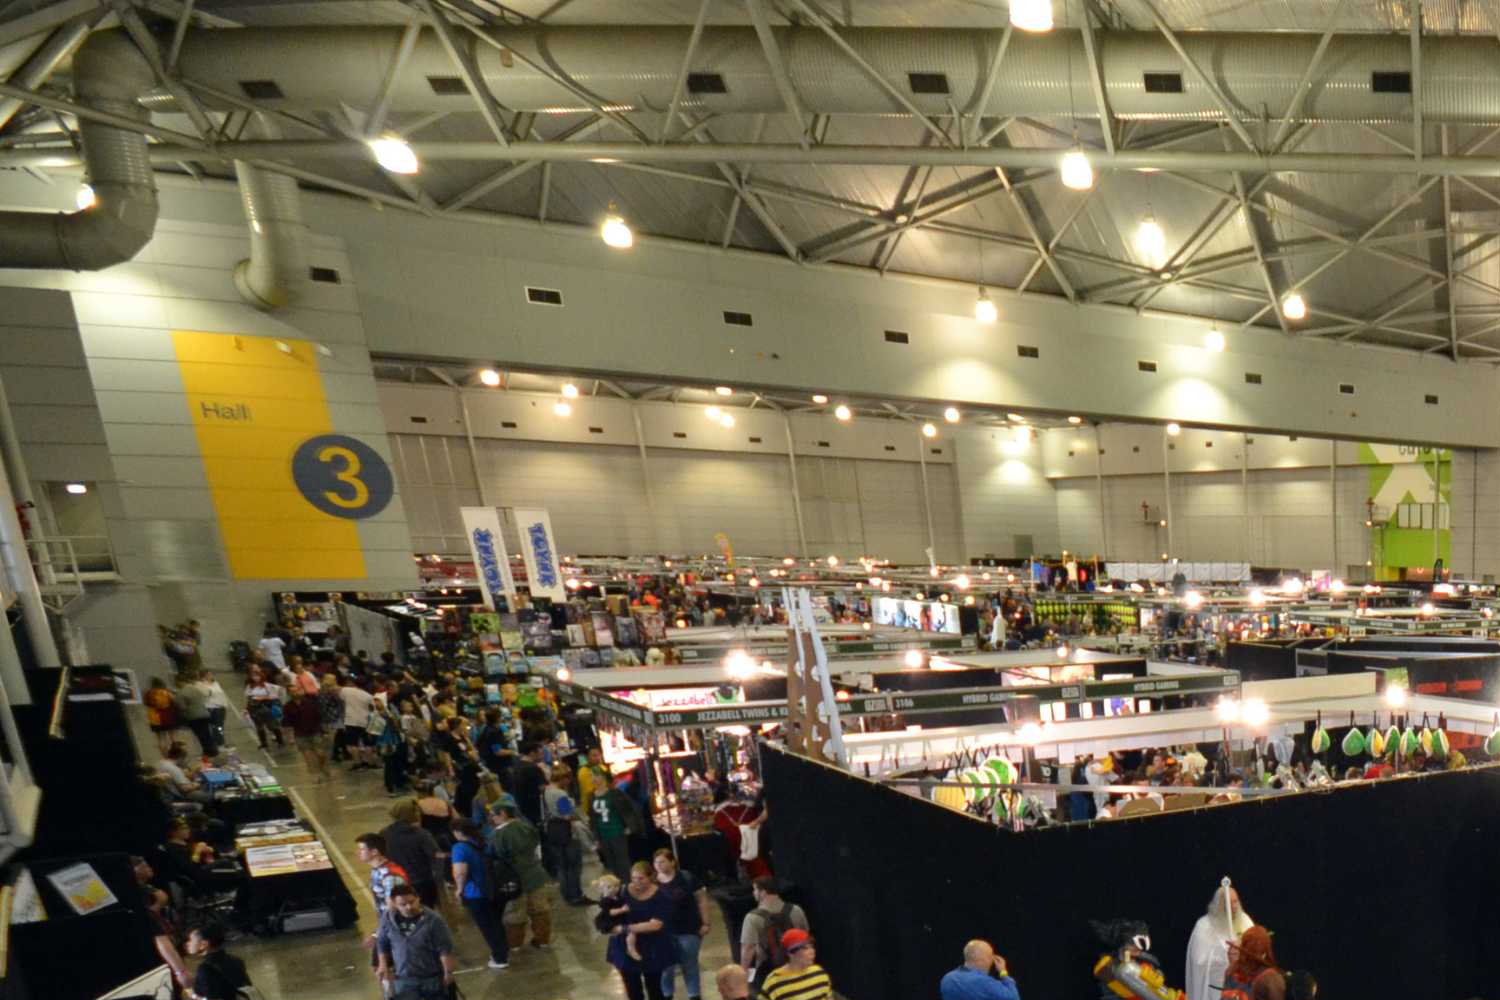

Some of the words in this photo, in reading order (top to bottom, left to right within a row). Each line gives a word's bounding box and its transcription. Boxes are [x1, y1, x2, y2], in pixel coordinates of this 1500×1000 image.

[200, 402, 249, 421] Hall
[319, 446, 369, 509] 3
[592, 799, 609, 823] 4
